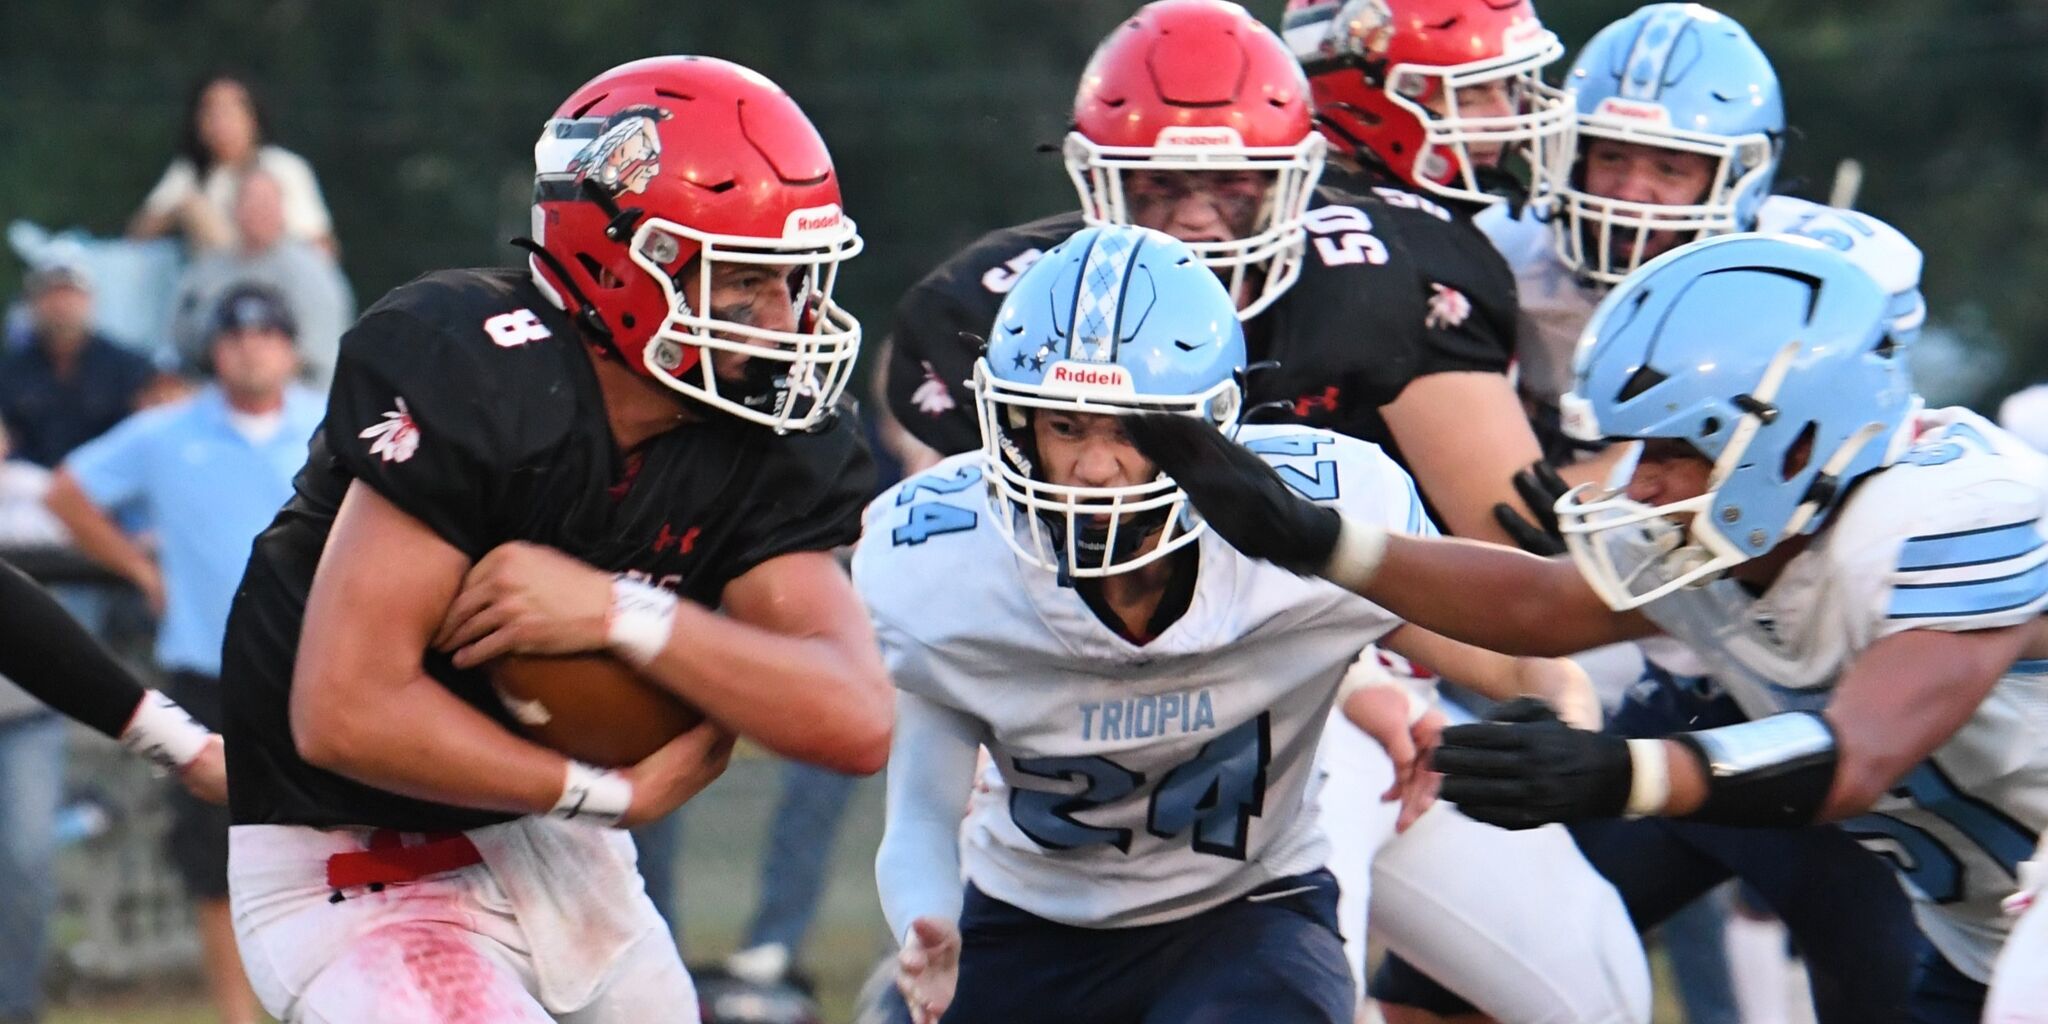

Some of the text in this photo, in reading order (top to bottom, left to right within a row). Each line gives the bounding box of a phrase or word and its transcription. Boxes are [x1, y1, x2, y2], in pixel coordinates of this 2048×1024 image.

[1302, 205, 1389, 266] 50
[484, 310, 553, 347] 8
[1056, 366, 1122, 386] Riddell
[1243, 434, 1340, 501] 24
[892, 465, 983, 547] 24
[1079, 689, 1215, 741] TRIOPIA
[1009, 710, 1271, 861] 24
